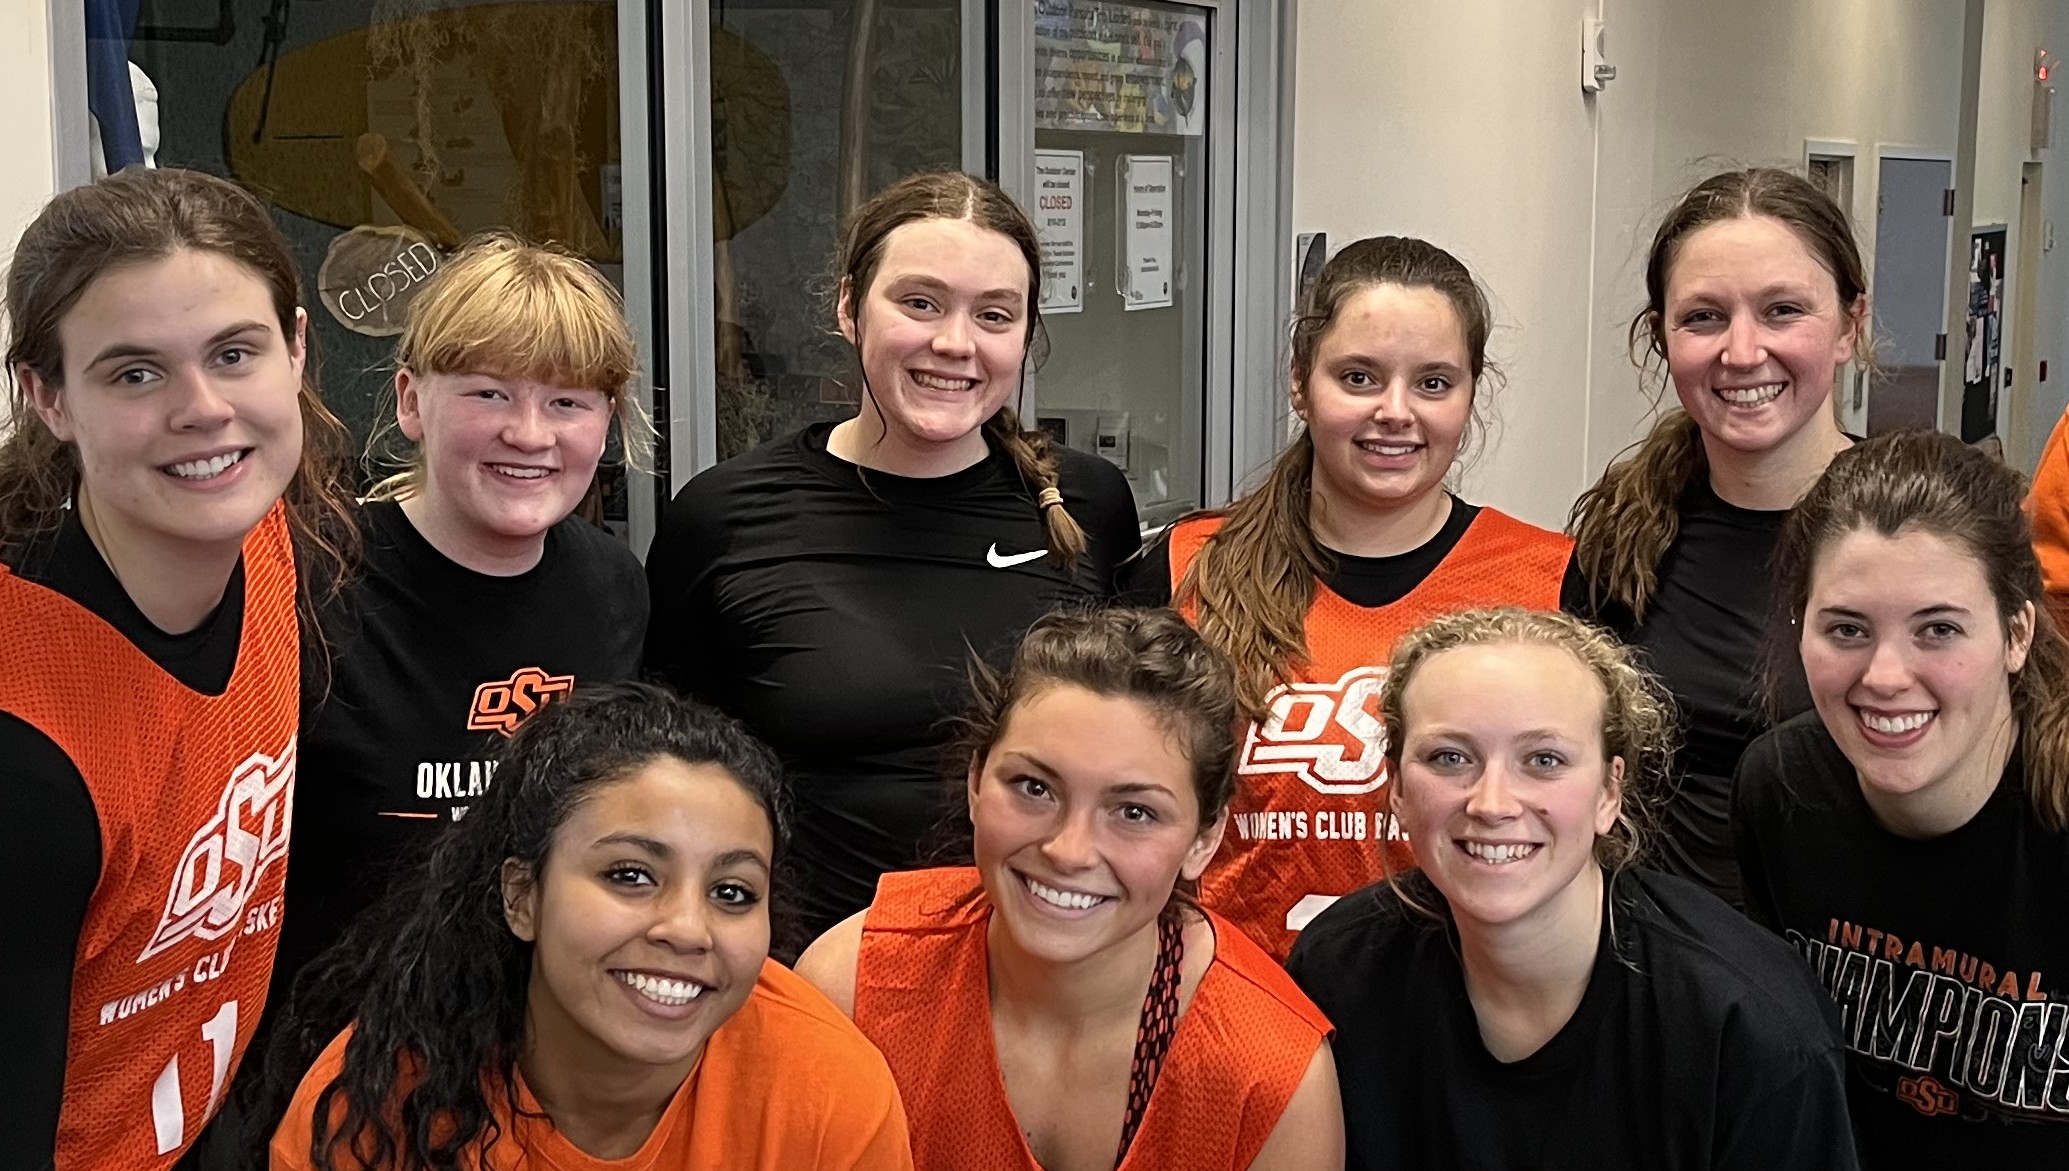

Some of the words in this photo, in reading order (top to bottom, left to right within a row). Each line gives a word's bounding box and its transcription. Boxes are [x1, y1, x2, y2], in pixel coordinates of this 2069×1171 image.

[1039, 195, 1073, 210] CLOSED
[339, 242, 437, 320] CLOSED
[1238, 666, 1388, 794] OS
[137, 734, 297, 963] OSU
[1234, 811, 1308, 841] WOMEN'S
[1315, 811, 1366, 841] CLUB
[1828, 918, 2047, 1001] INTRAMURAL
[1786, 929, 2069, 1112] AMPION
[1896, 1075, 1960, 1117] OSU
